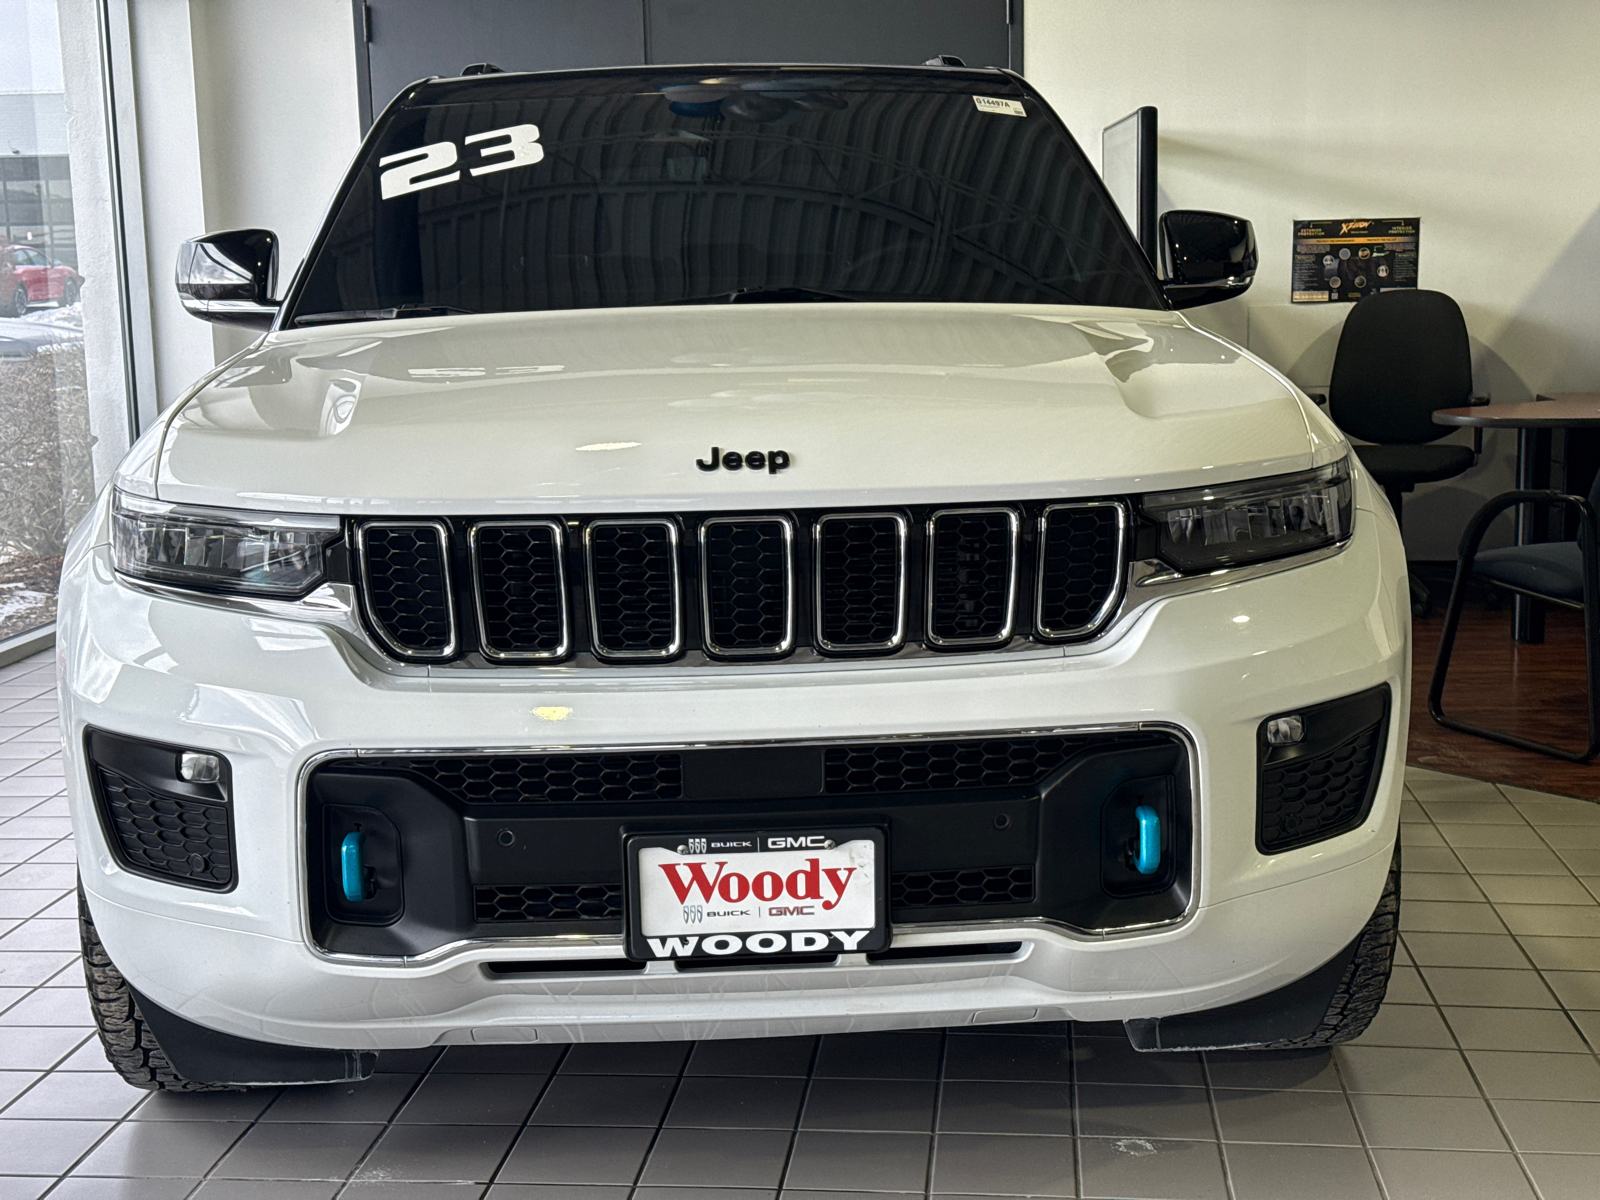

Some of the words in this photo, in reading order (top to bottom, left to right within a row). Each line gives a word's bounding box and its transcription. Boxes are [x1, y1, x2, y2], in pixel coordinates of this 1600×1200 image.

[379, 124, 544, 200] 23
[696, 446, 790, 475] Jeep
[711, 840, 752, 848] BUICK
[768, 836, 825, 849] GMC
[658, 858, 857, 910] Woody
[706, 909, 751, 917] BUICK
[768, 906, 815, 916] GMC
[647, 930, 870, 958] WOODY
